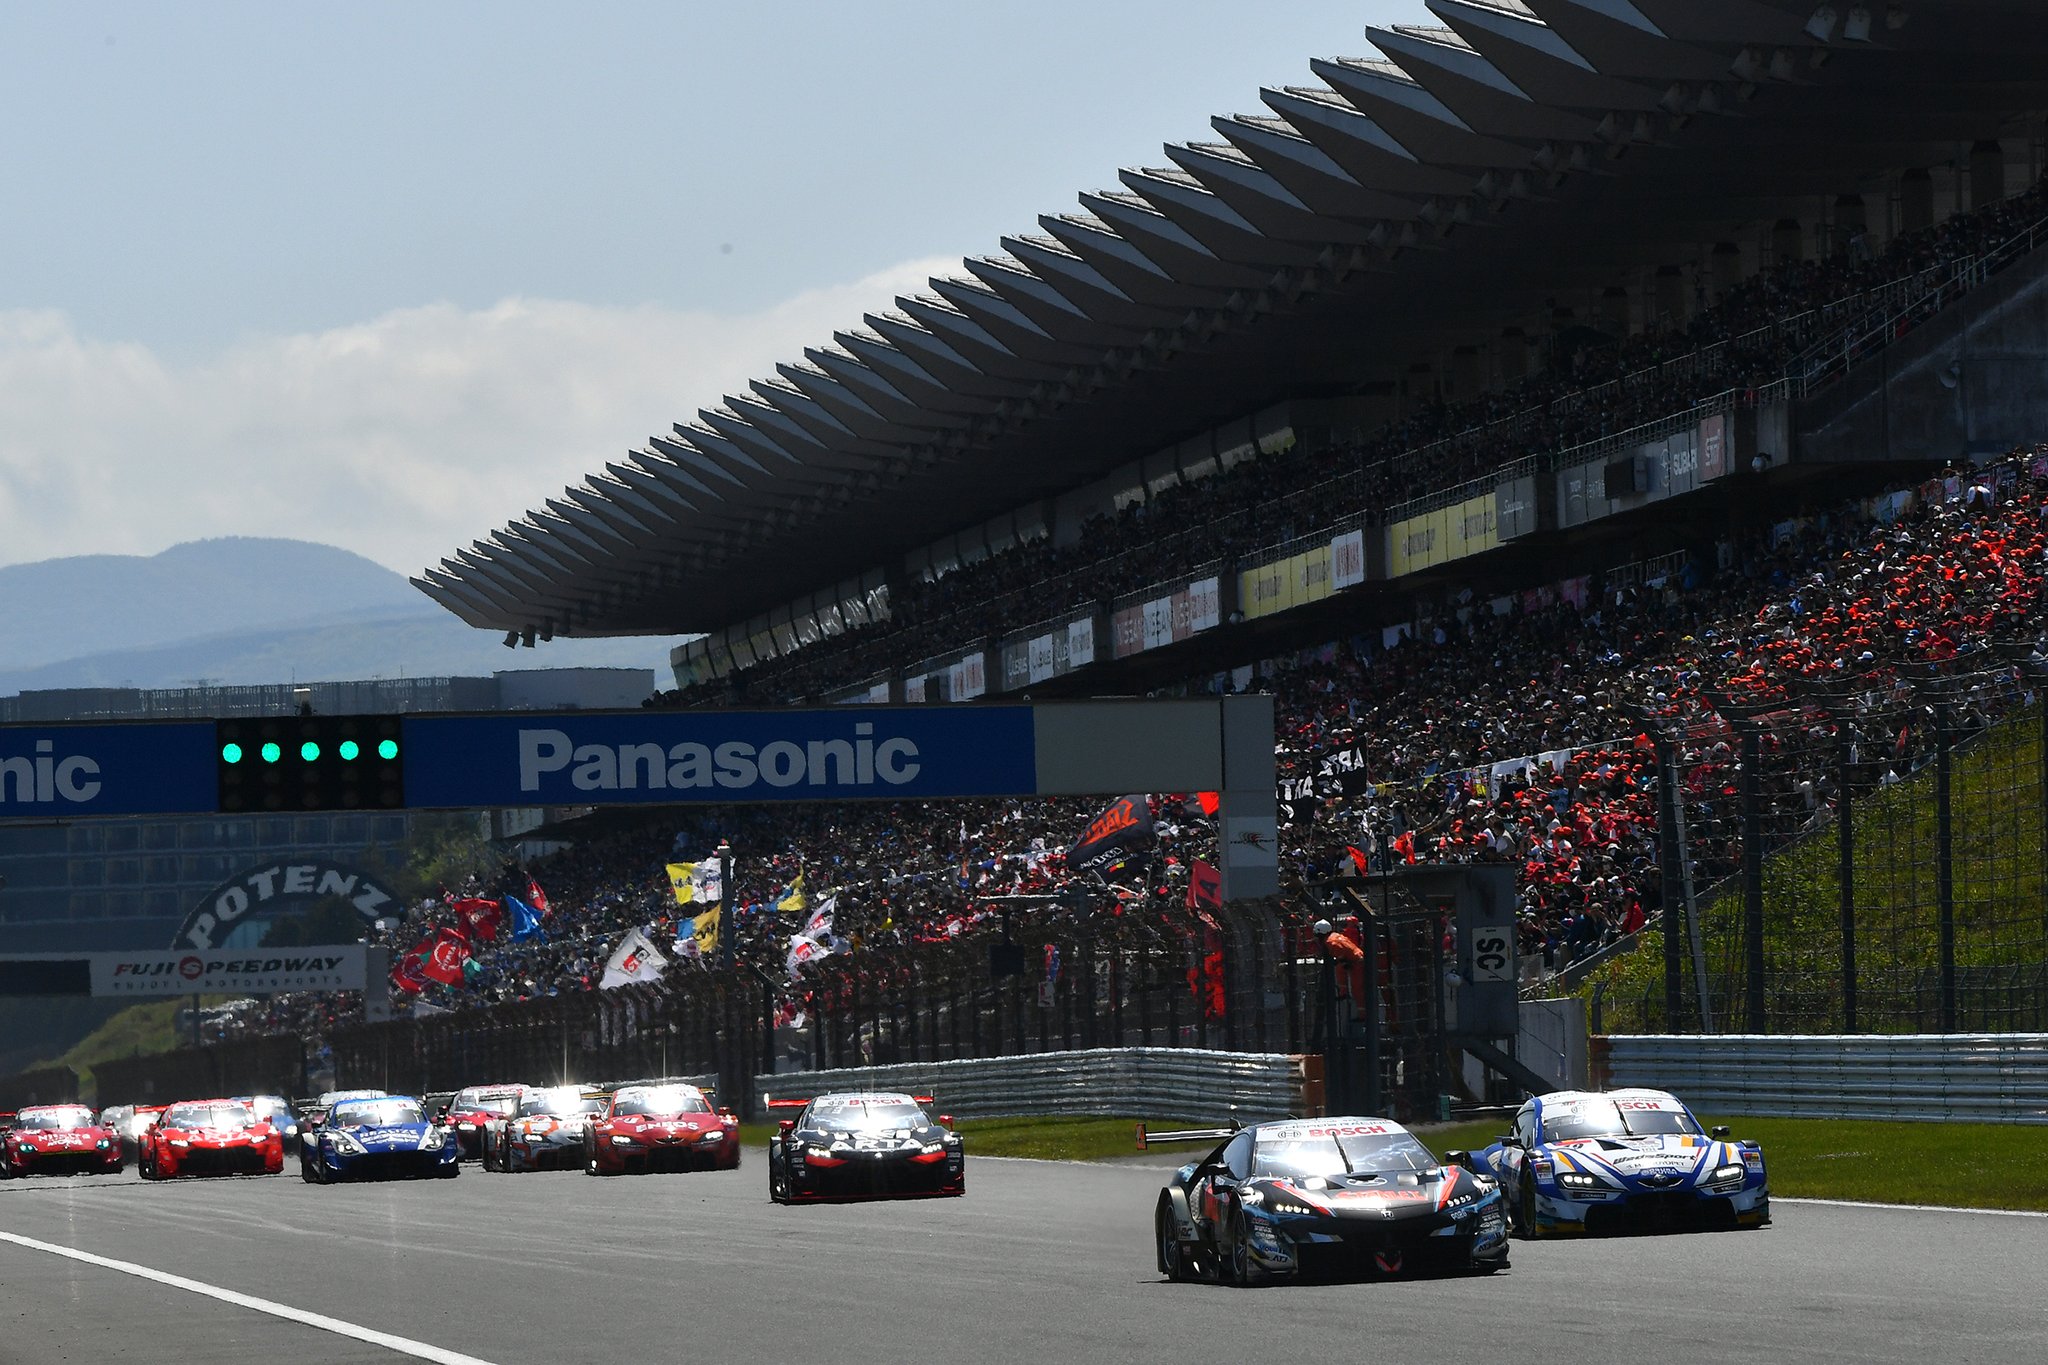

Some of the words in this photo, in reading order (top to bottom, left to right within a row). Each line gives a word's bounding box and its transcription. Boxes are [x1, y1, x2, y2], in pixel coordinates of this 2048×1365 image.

[518, 722, 921, 792] Panasonic
[0, 740, 101, 803] nic
[1476, 938, 1506, 970] SC
[113, 962, 176, 978] FUJI
[636, 1121, 699, 1133] ENEOS
[1309, 1126, 1387, 1138] BOSCH
[831, 1138, 925, 1152] ARTA
[1613, 1152, 1696, 1165] WedsSport
